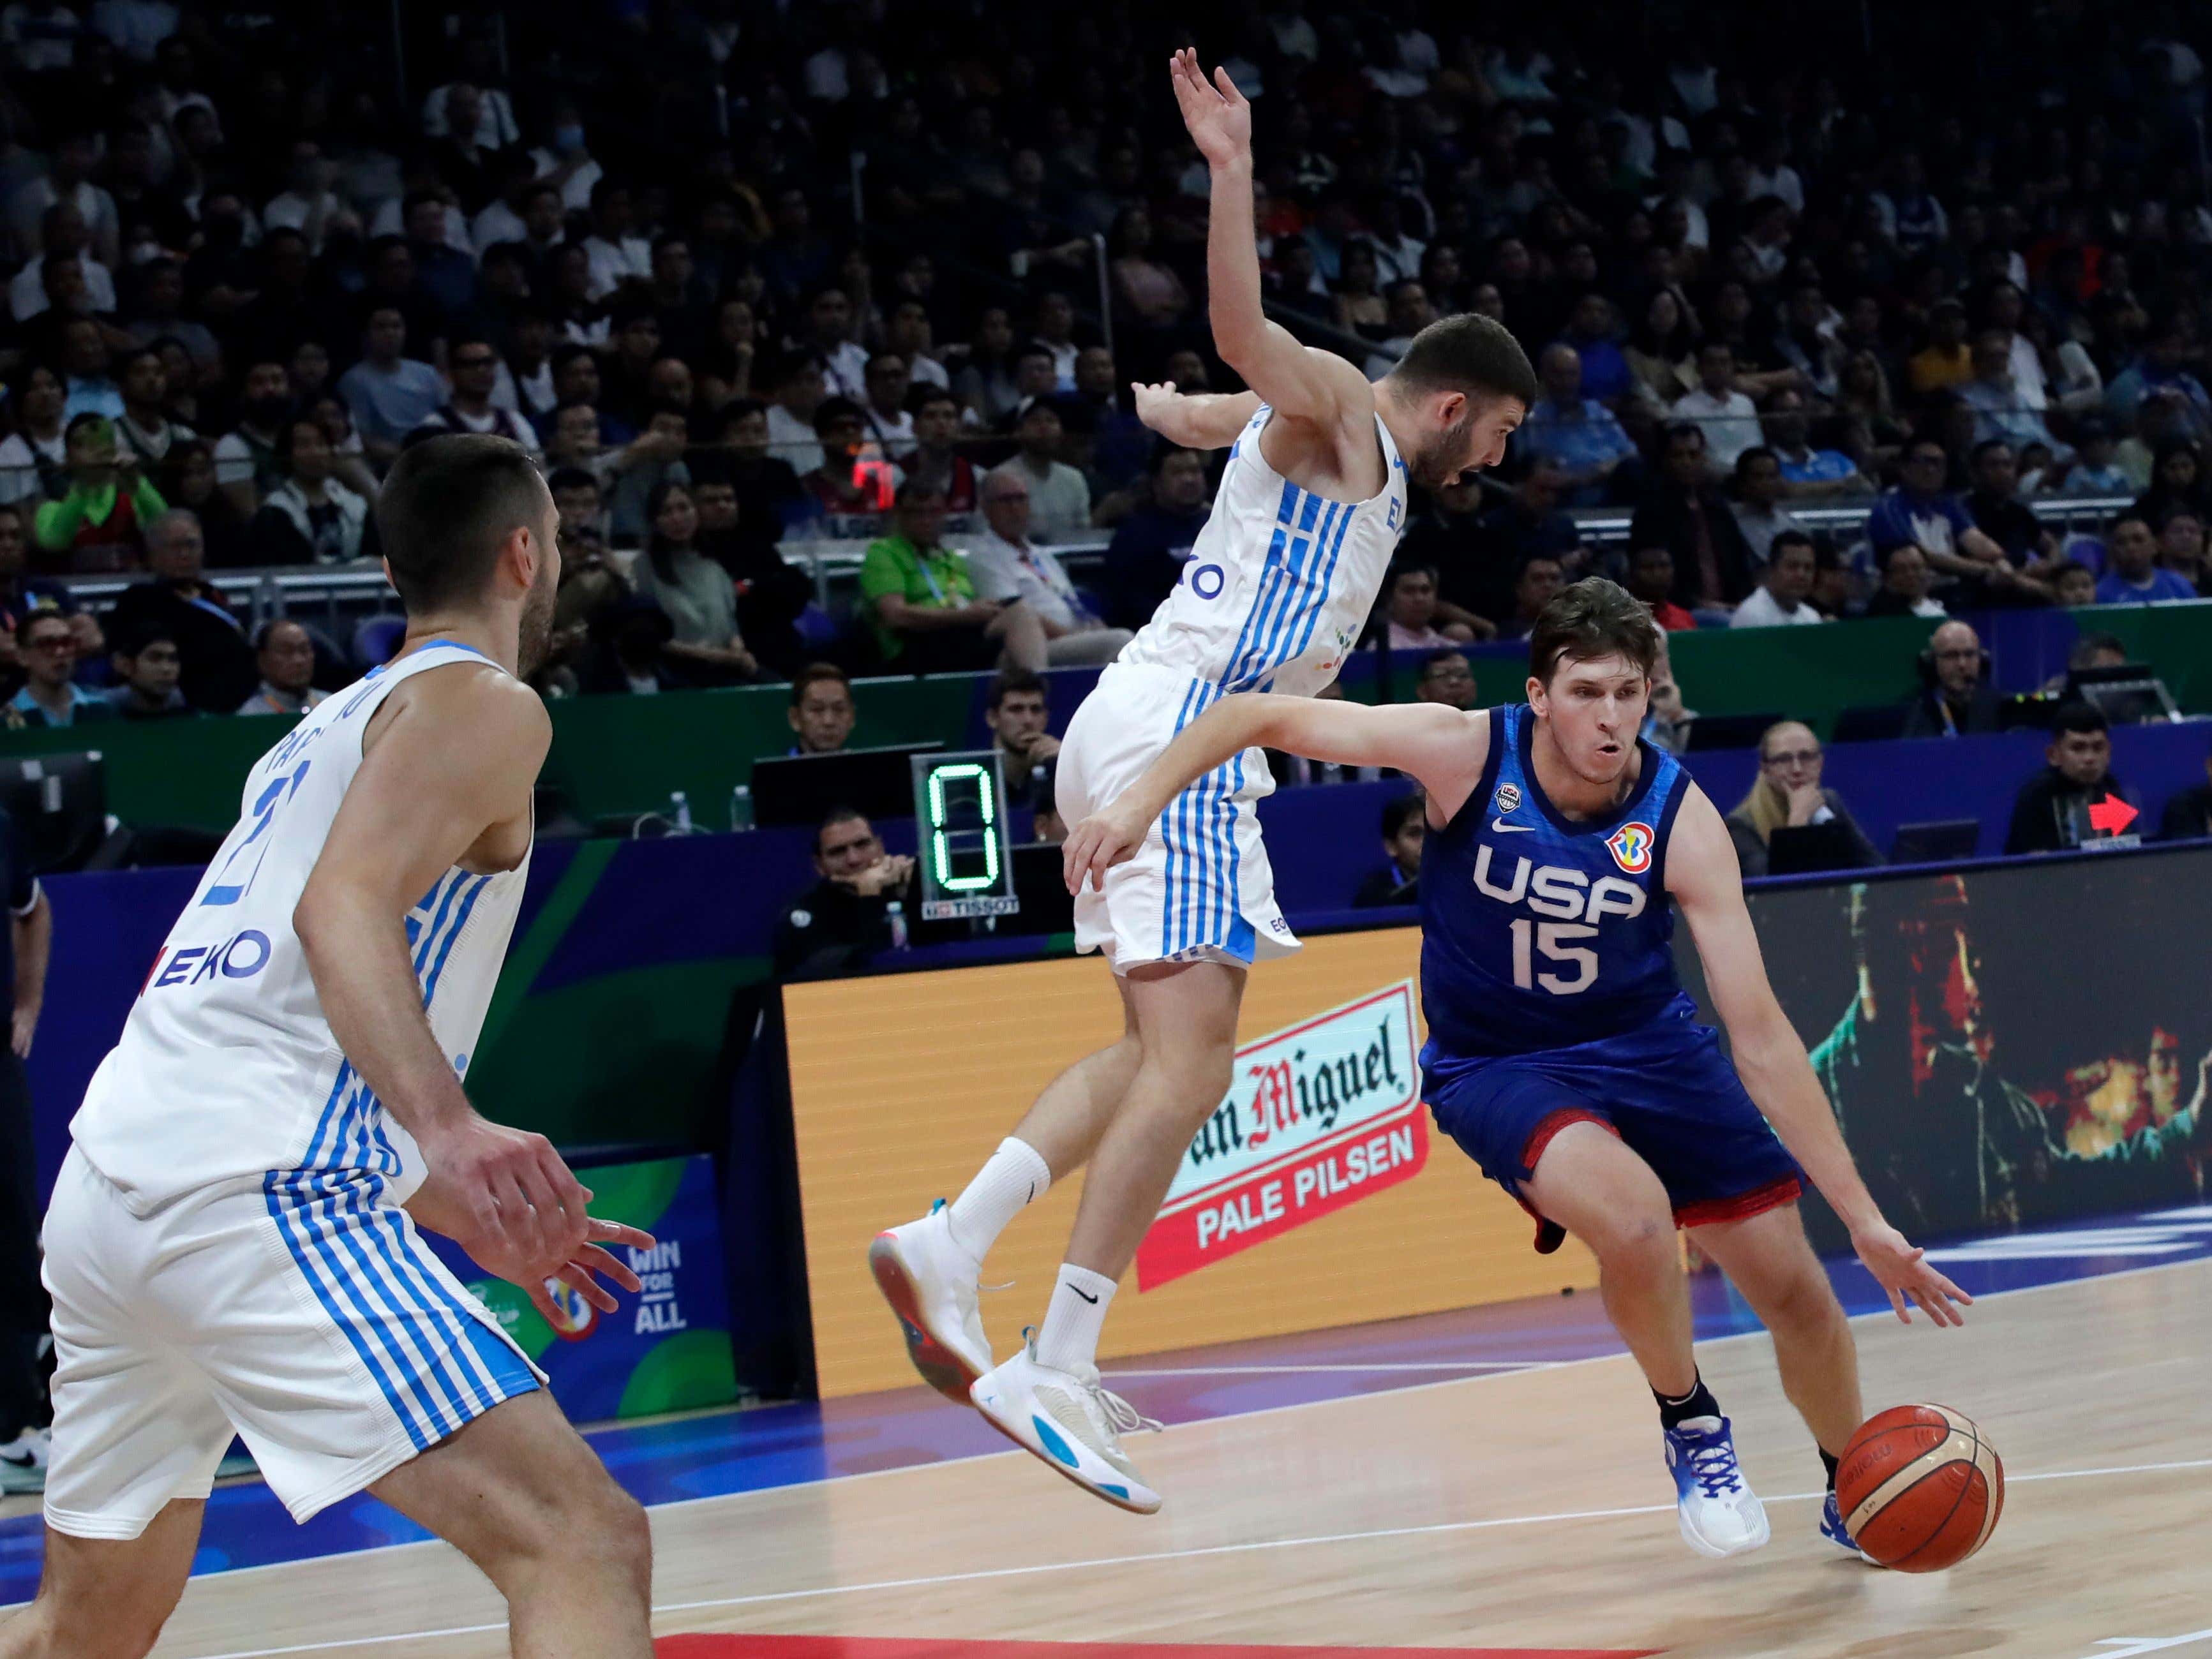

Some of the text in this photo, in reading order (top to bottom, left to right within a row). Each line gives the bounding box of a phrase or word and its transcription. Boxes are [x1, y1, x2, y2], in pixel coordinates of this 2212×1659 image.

[929, 764, 999, 890] 0
[1473, 844, 1648, 925] USA
[154, 929, 272, 988] EKO
[1509, 918, 1599, 995] 15
[1190, 1013, 1397, 1168] an Miguel
[1195, 1124, 1415, 1249] PALE PILSEN
[628, 1240, 681, 1273] WIN
[640, 1271, 674, 1291] FOR
[634, 1301, 687, 1335] ALL
